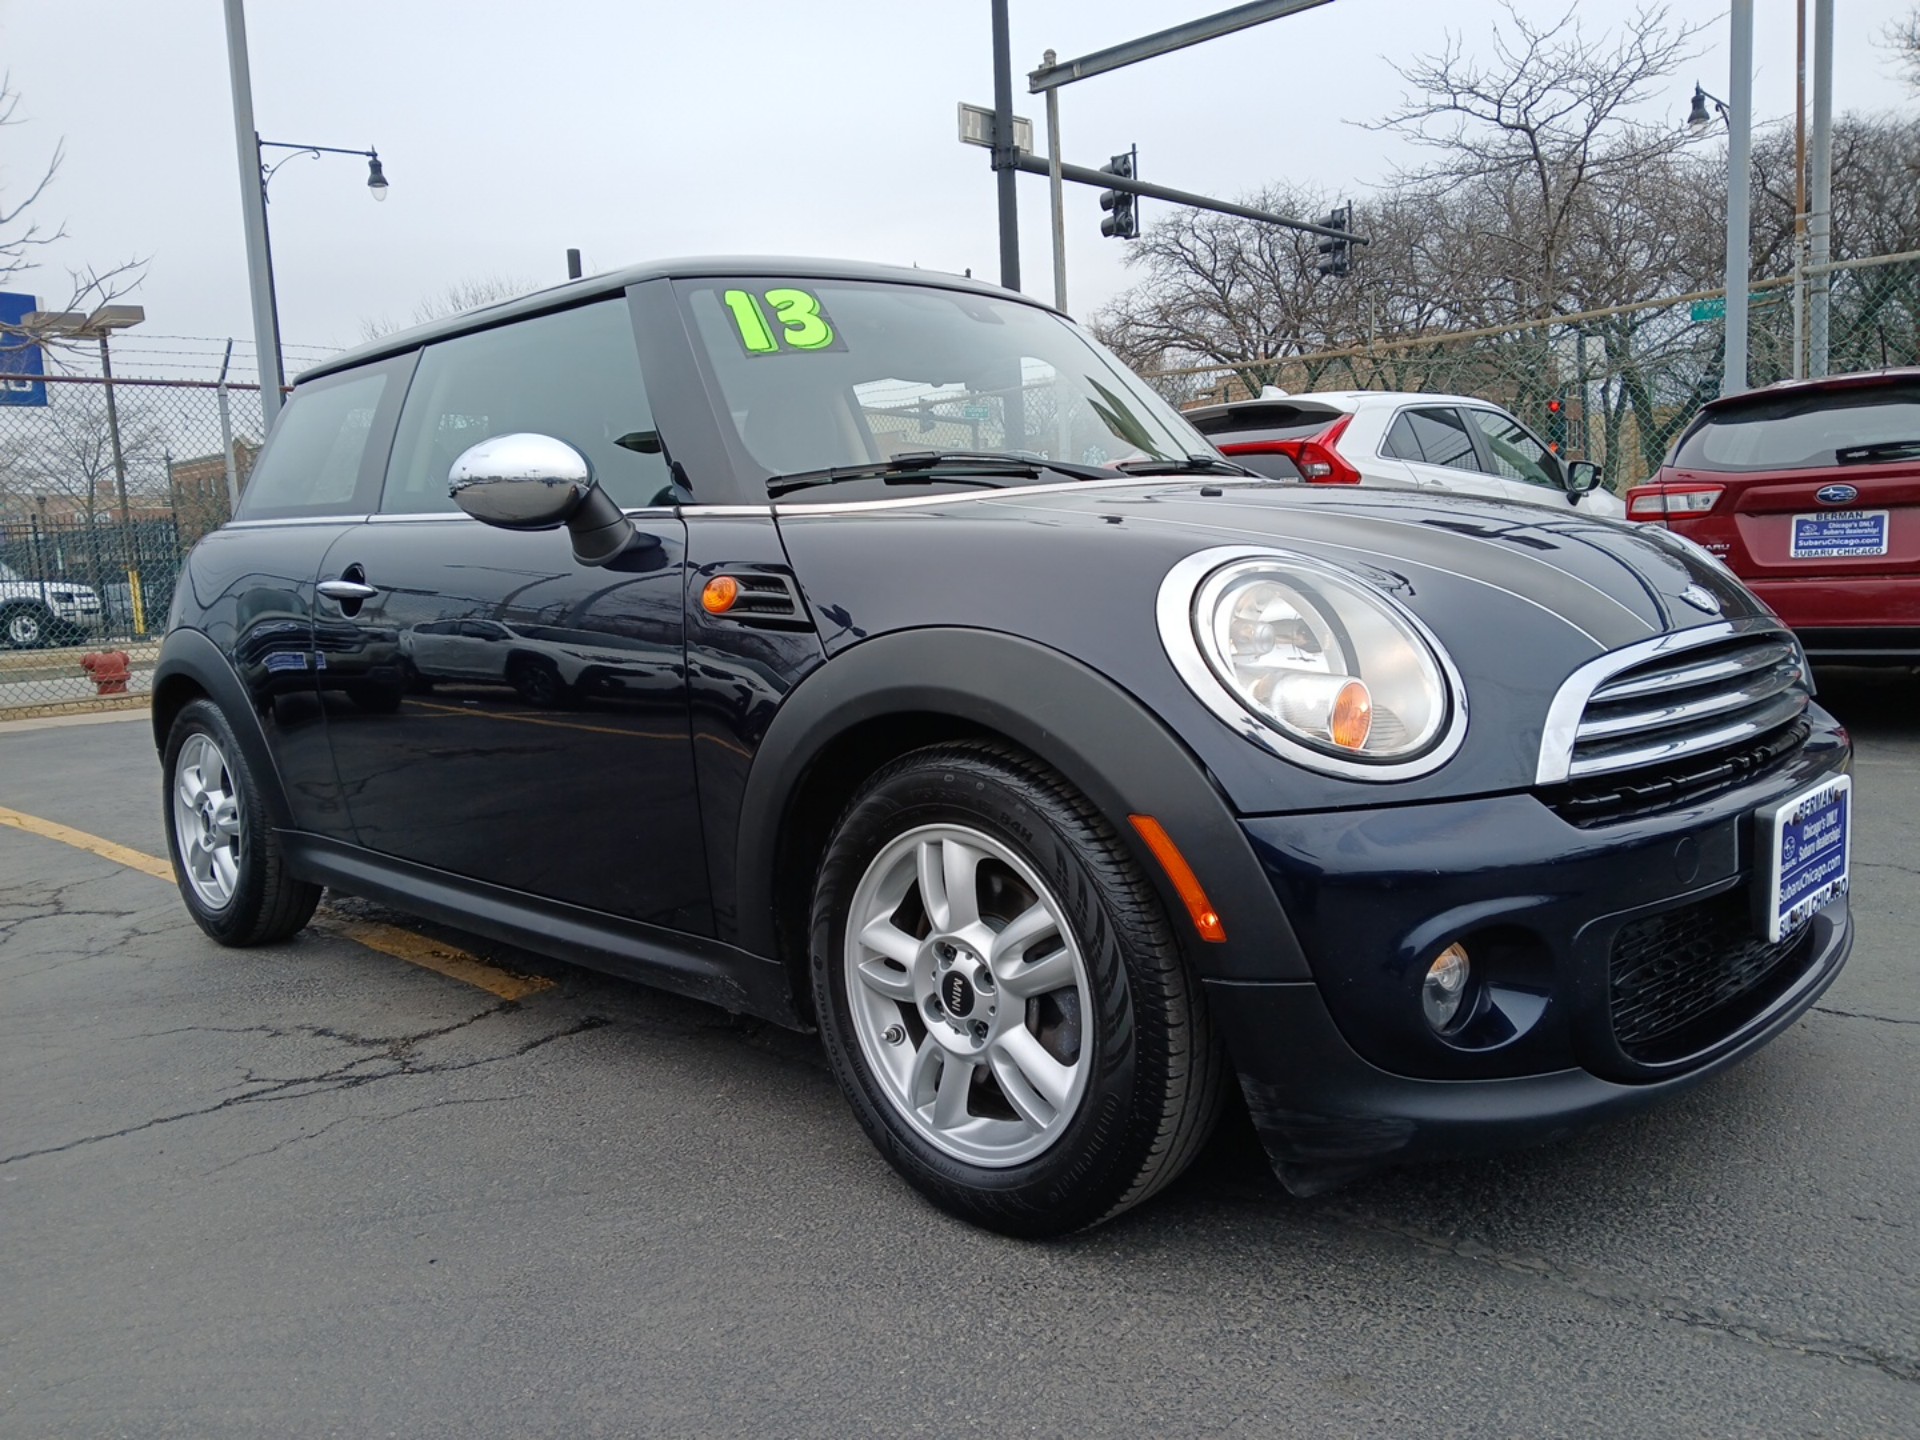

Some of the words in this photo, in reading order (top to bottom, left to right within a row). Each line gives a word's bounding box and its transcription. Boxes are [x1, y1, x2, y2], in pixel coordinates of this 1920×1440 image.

[724, 288, 834, 353] 13
[1816, 511, 1863, 521] BERMAN
[1794, 549, 1834, 557] SUBARU
[1837, 547, 1883, 555] CHICAGO
[1798, 538, 1880, 547] SubaruChicago.com
[1799, 786, 1834, 820] BERMAN
[1803, 816, 1826, 841] Chicago's
[1826, 808, 1838, 828] ONLY
[1799, 843, 1815, 862] Subaru
[1780, 854, 1841, 905] SubaruChicago.com
[951, 977, 964, 1012] MINI
